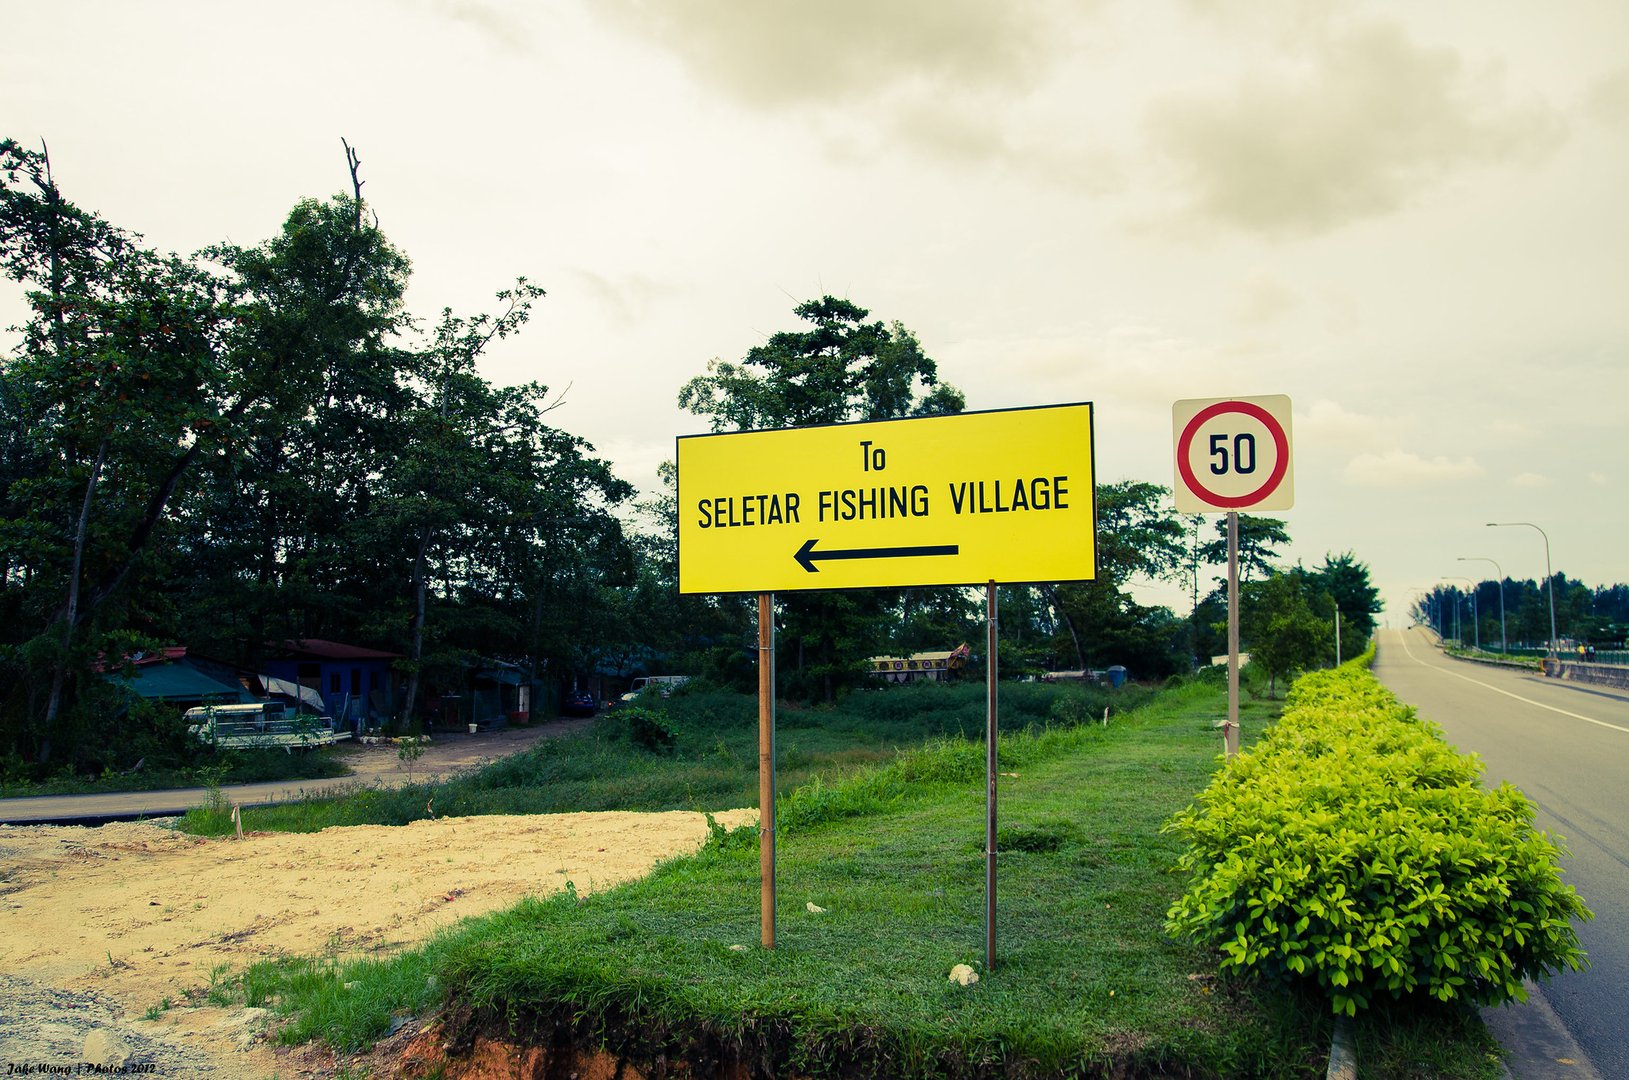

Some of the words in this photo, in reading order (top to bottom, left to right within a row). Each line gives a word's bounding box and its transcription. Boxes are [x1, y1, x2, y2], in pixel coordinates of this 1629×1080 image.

[859, 441, 886, 472] To
[1209, 433, 1256, 476] 50
[698, 493, 800, 529] SELETAR
[819, 484, 929, 523] FISHING
[949, 475, 1070, 515] VILLAGE
